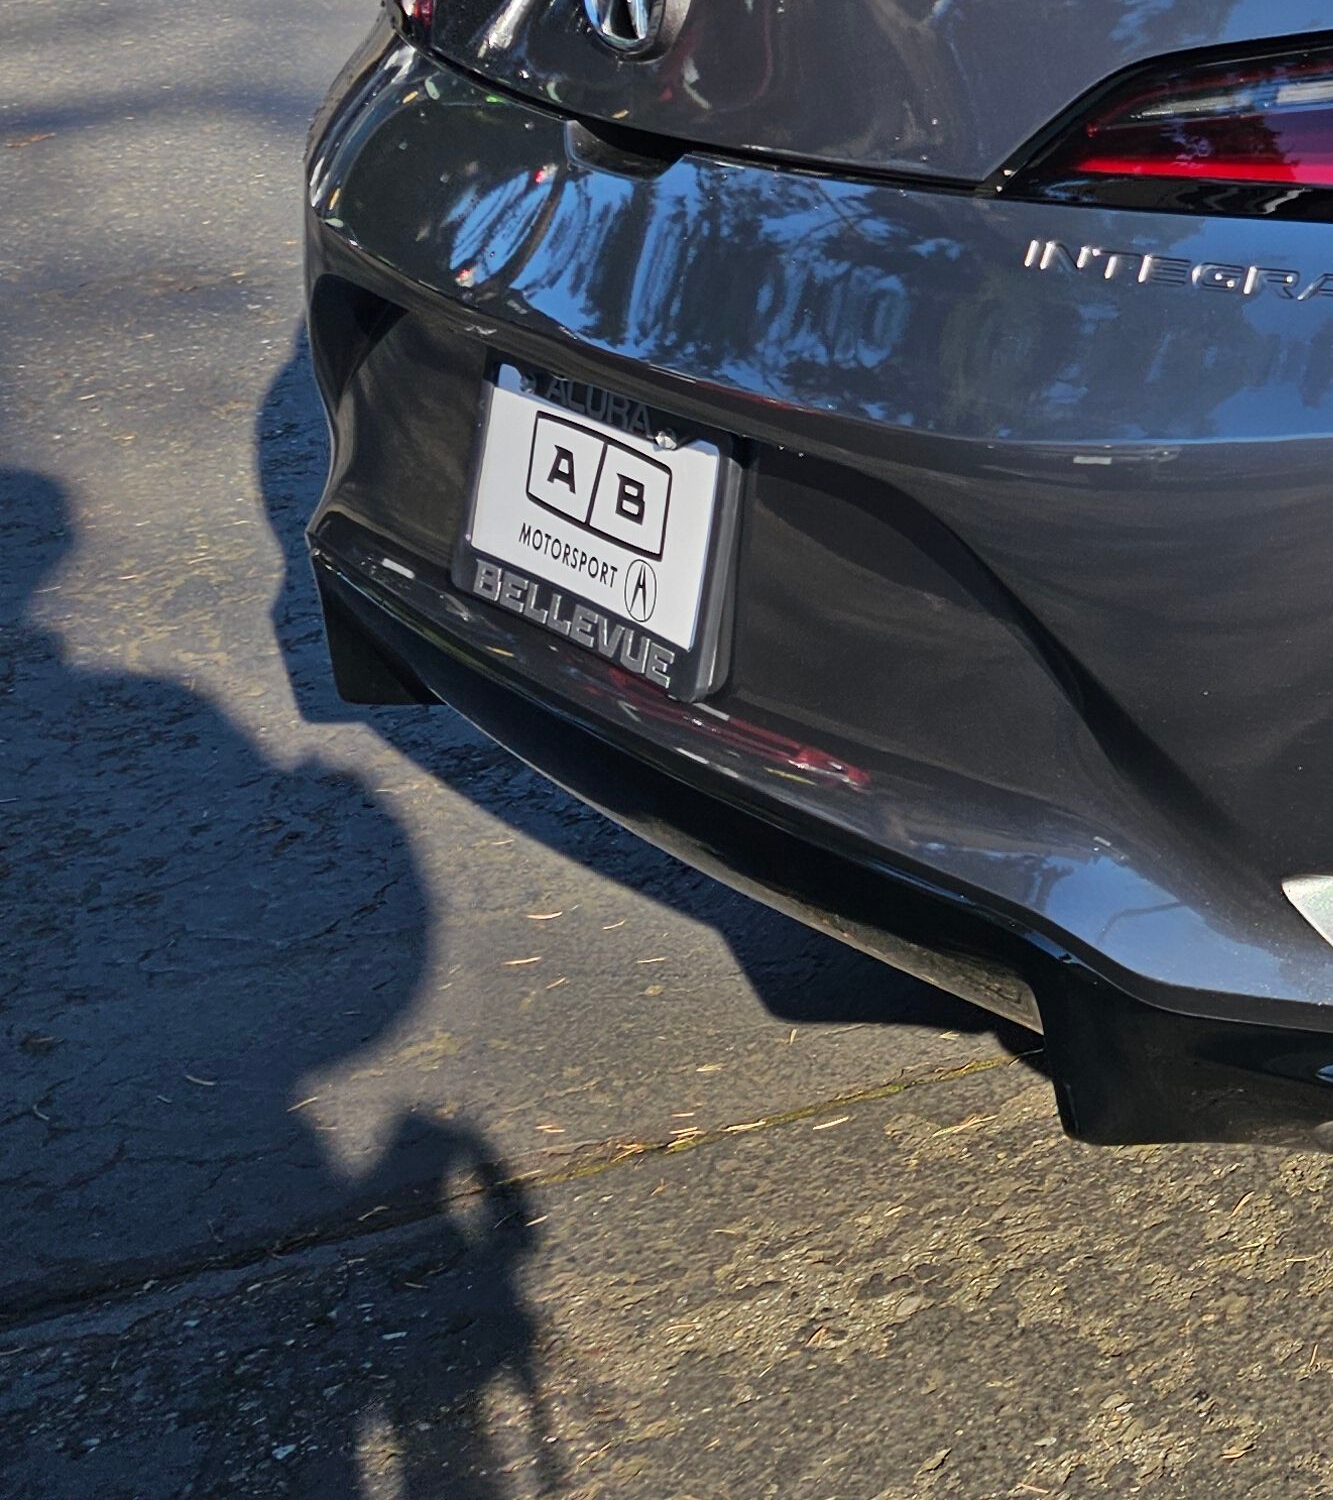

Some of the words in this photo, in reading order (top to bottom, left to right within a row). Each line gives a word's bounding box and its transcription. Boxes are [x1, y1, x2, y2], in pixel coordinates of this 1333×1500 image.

[546, 444, 577, 495] A
[615, 472, 646, 526] B
[518, 522, 619, 589] MOTORSPORT
[472, 558, 676, 689] BELLEVUE
